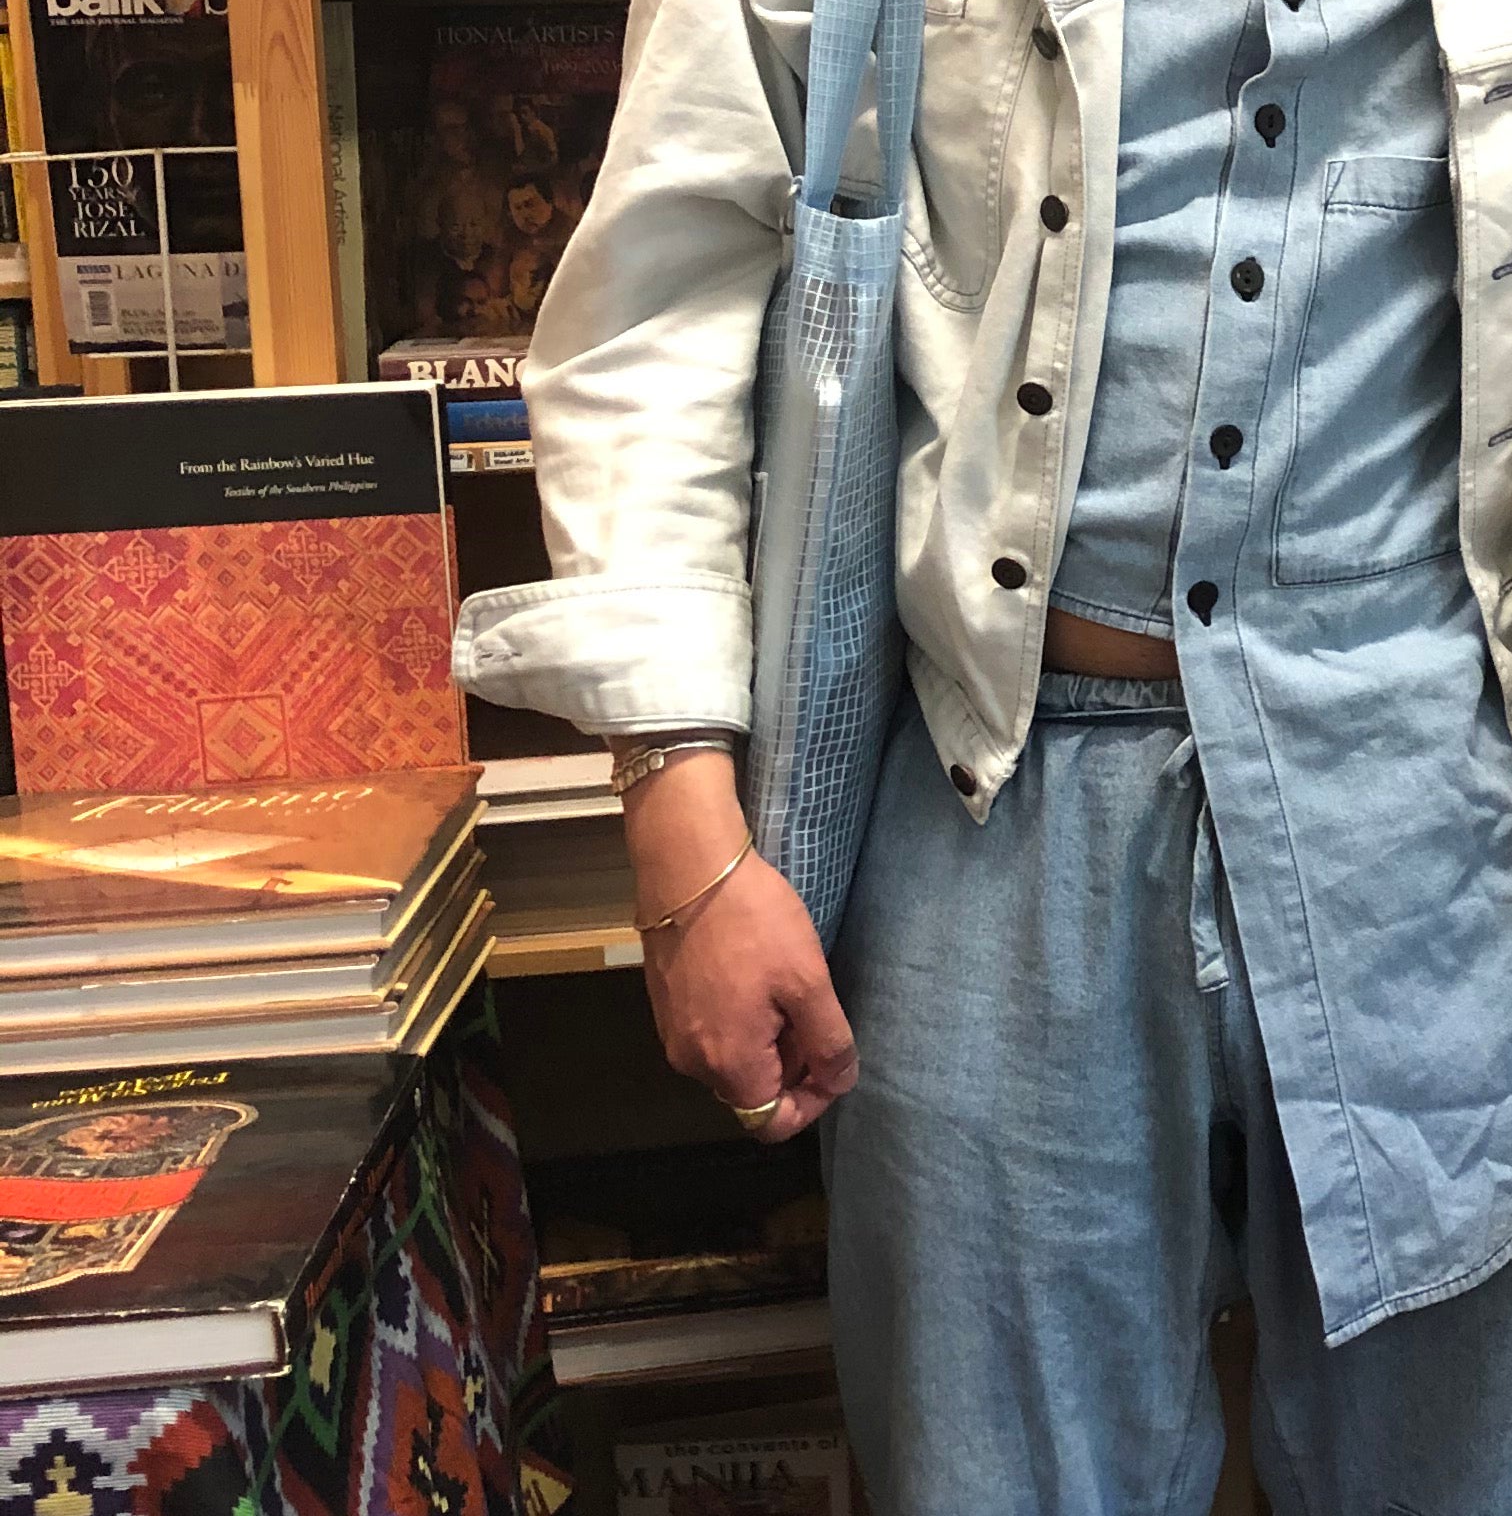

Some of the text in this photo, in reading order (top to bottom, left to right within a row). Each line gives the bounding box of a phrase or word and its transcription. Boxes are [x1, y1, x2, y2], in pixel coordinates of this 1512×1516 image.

[529, 24, 616, 44] ARTISTS
[70, 156, 133, 189] 150
[68, 187, 127, 201] YEARS
[334, 189, 349, 246] Artists
[74, 220, 146, 238] RIZAL
[115, 263, 217, 280] LAGNA
[179, 451, 375, 476] From the Rainbow's Varied Hue
[224, 478, 378, 499] Textiles of the Southern Philippines
